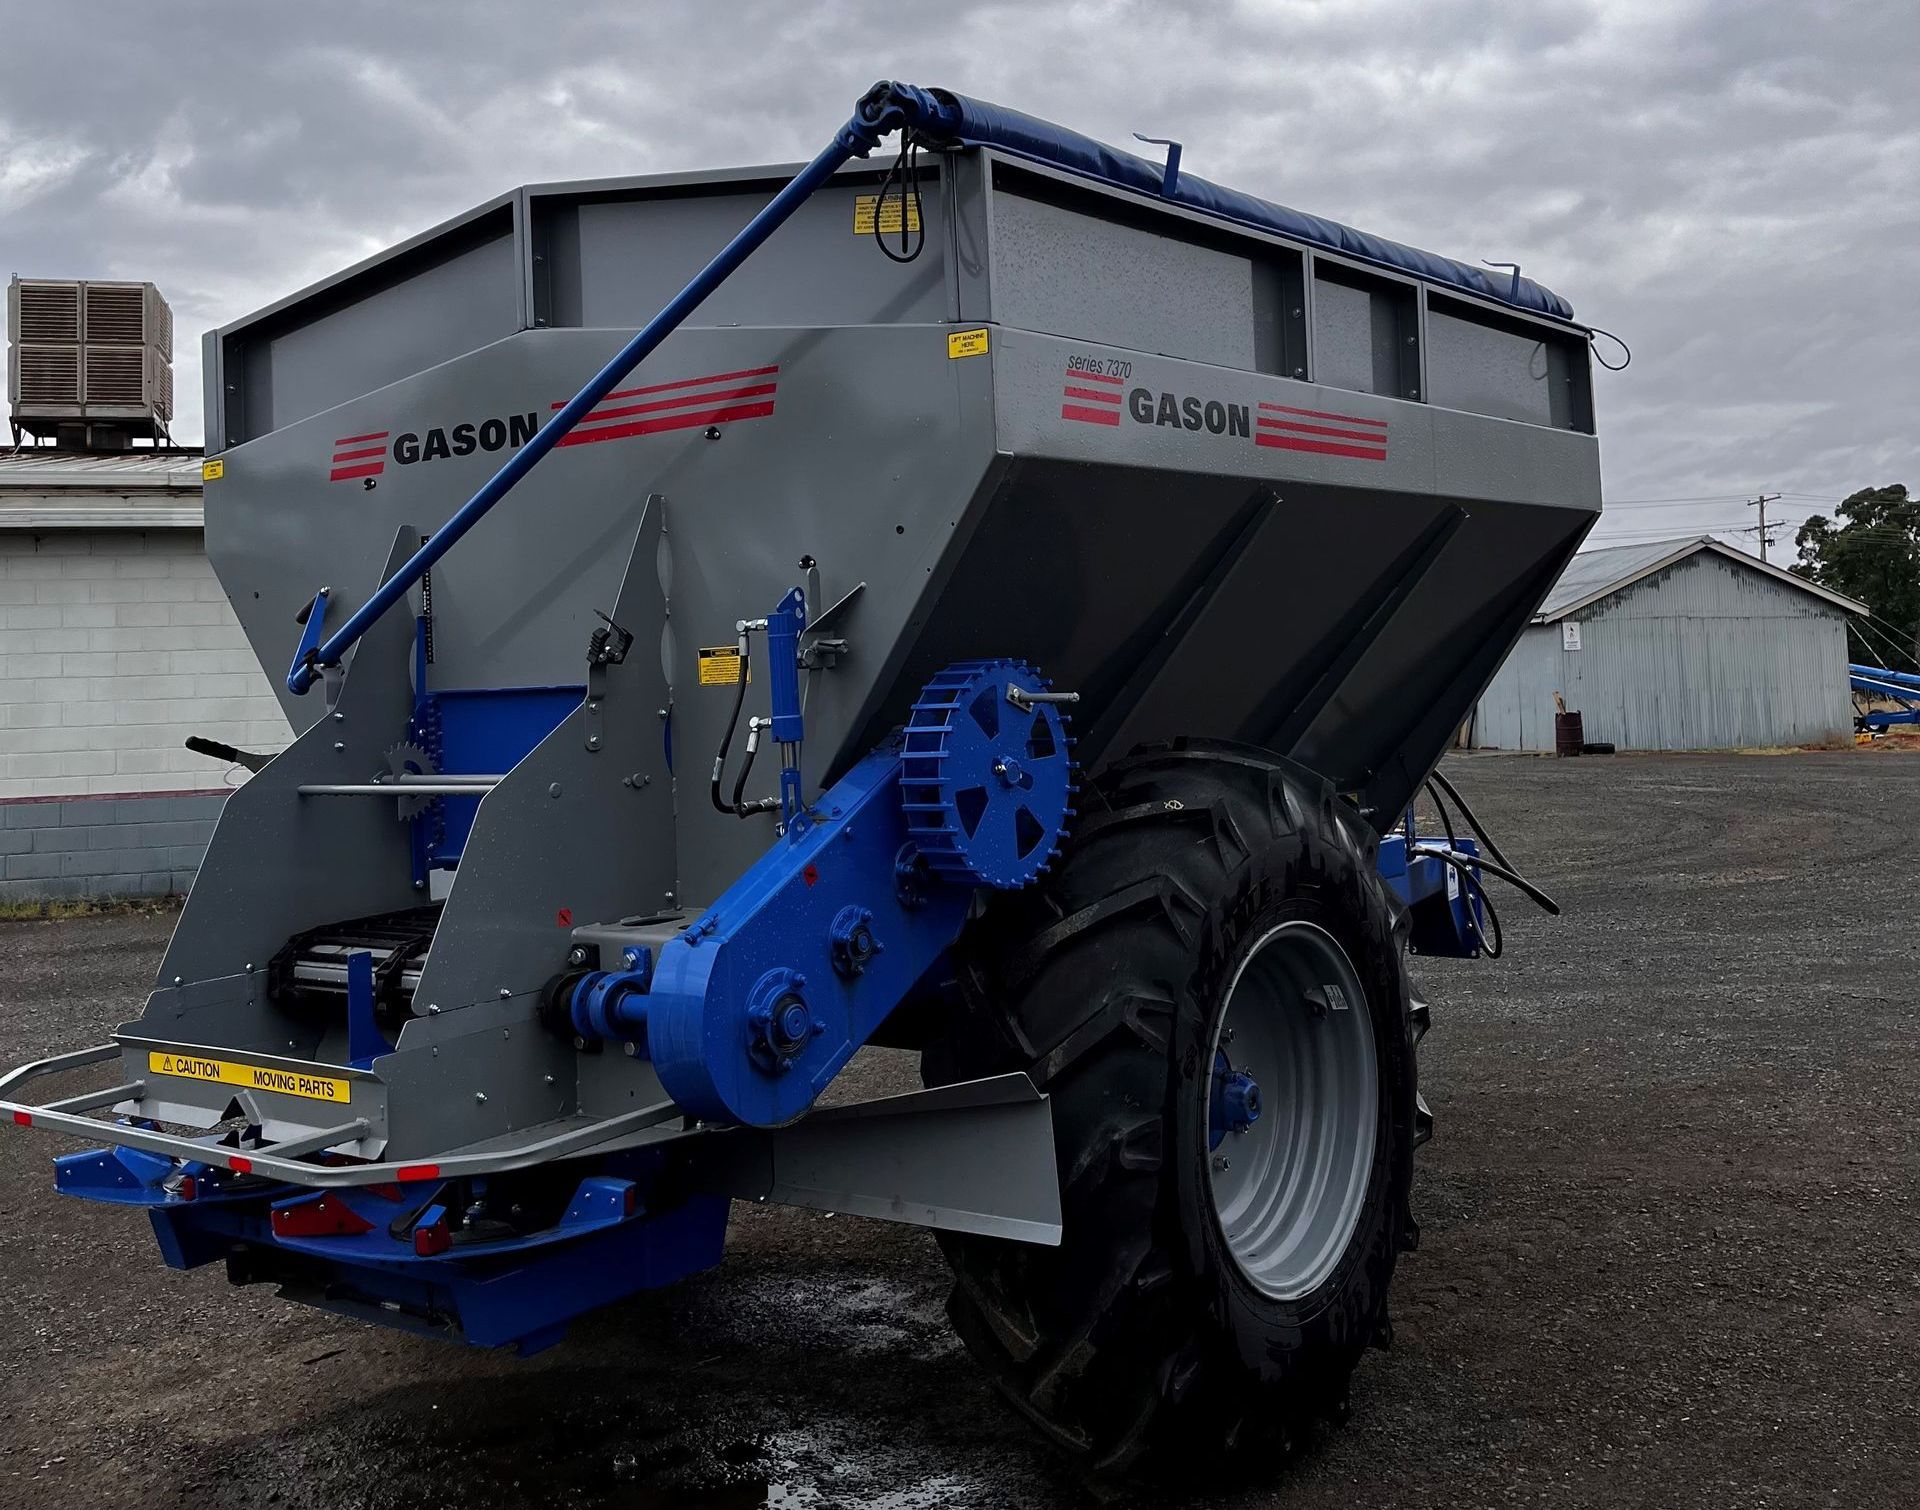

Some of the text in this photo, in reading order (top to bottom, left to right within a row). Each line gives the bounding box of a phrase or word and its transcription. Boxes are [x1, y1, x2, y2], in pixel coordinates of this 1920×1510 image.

[1068, 354, 1132, 379] series 7370
[1129, 388, 1250, 438] GASON
[393, 412, 538, 465] GASON
[176, 1058, 334, 1098] CAUTION MOVING PARTS
